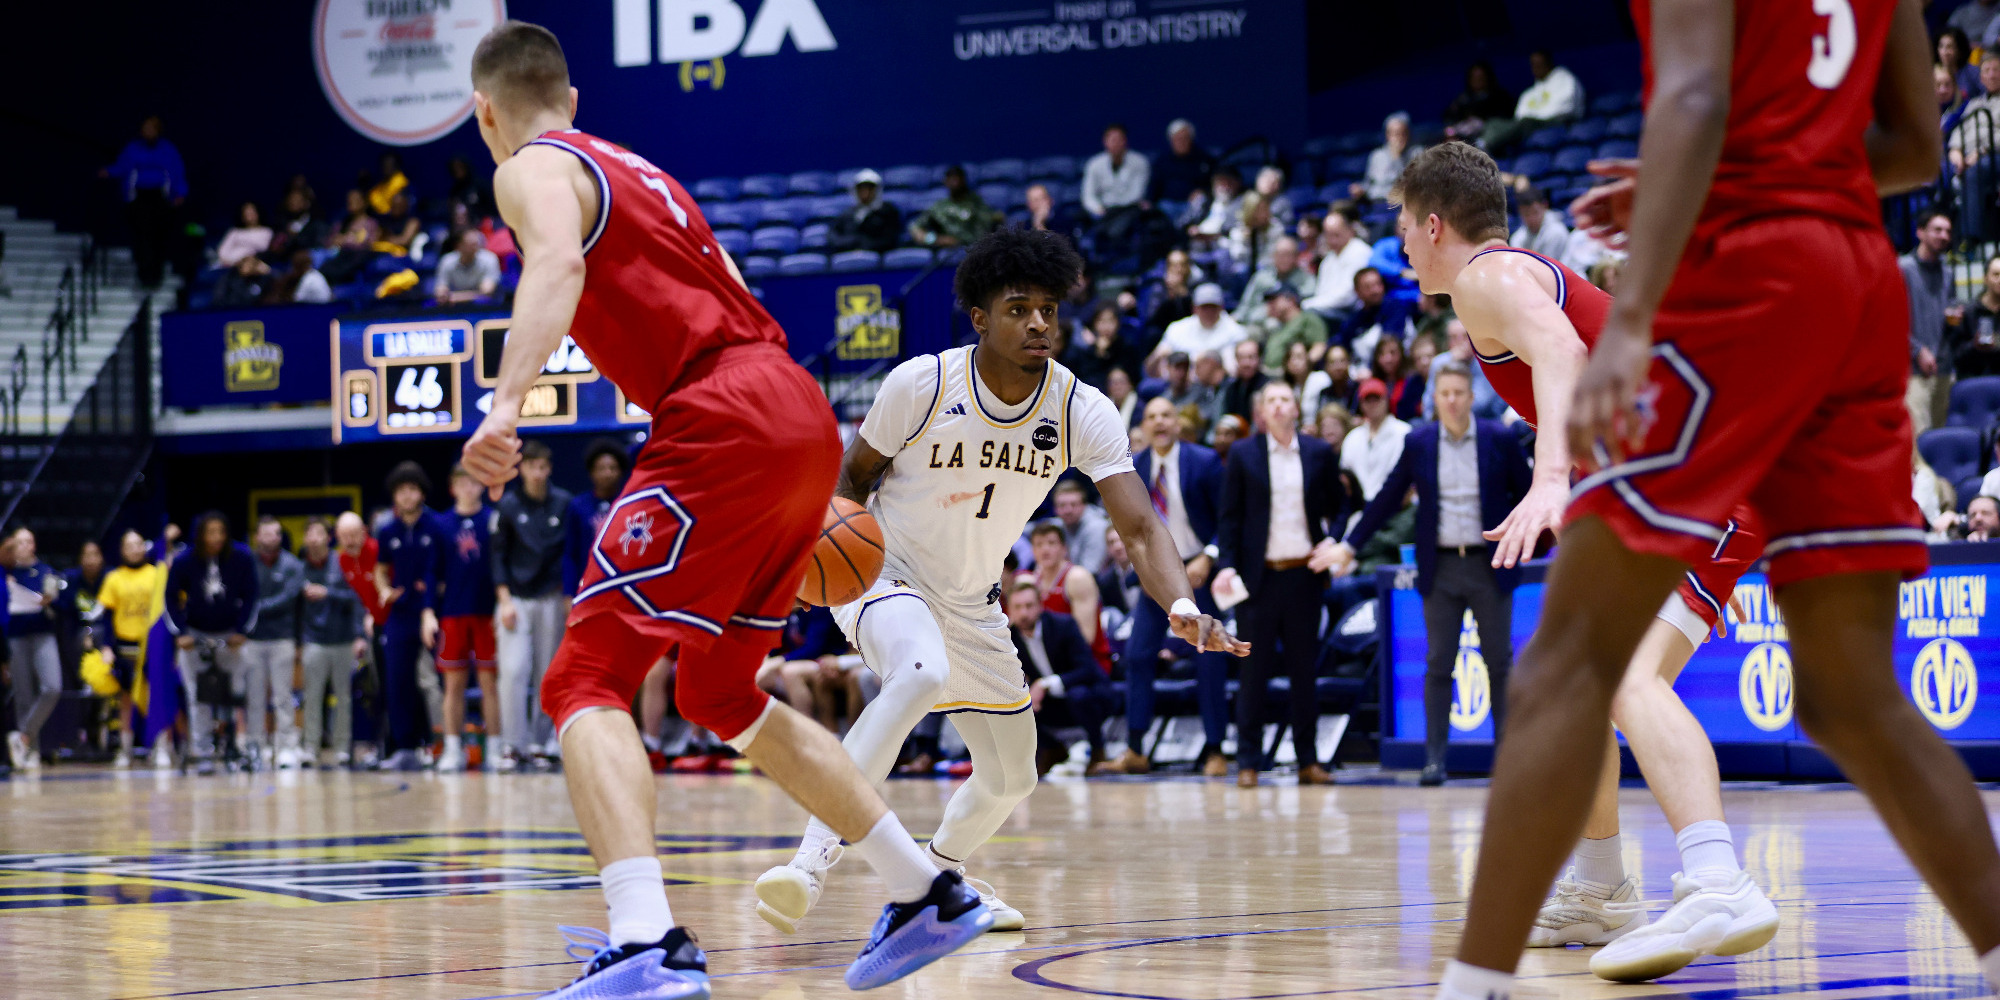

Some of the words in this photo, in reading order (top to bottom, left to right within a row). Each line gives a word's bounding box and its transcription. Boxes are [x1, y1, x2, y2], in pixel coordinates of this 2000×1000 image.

[953, 23, 1099, 60] UNIVERSAL
[1101, 9, 1247, 49] DENTISTRY
[395, 366, 443, 410] 46
[929, 442, 965, 469] LA
[979, 440, 1055, 479] SALLE
[975, 482, 996, 519] 1
[1899, 577, 1937, 620] CITY
[1939, 574, 1987, 619] VIEW
[1918, 640, 1970, 718] CVP
